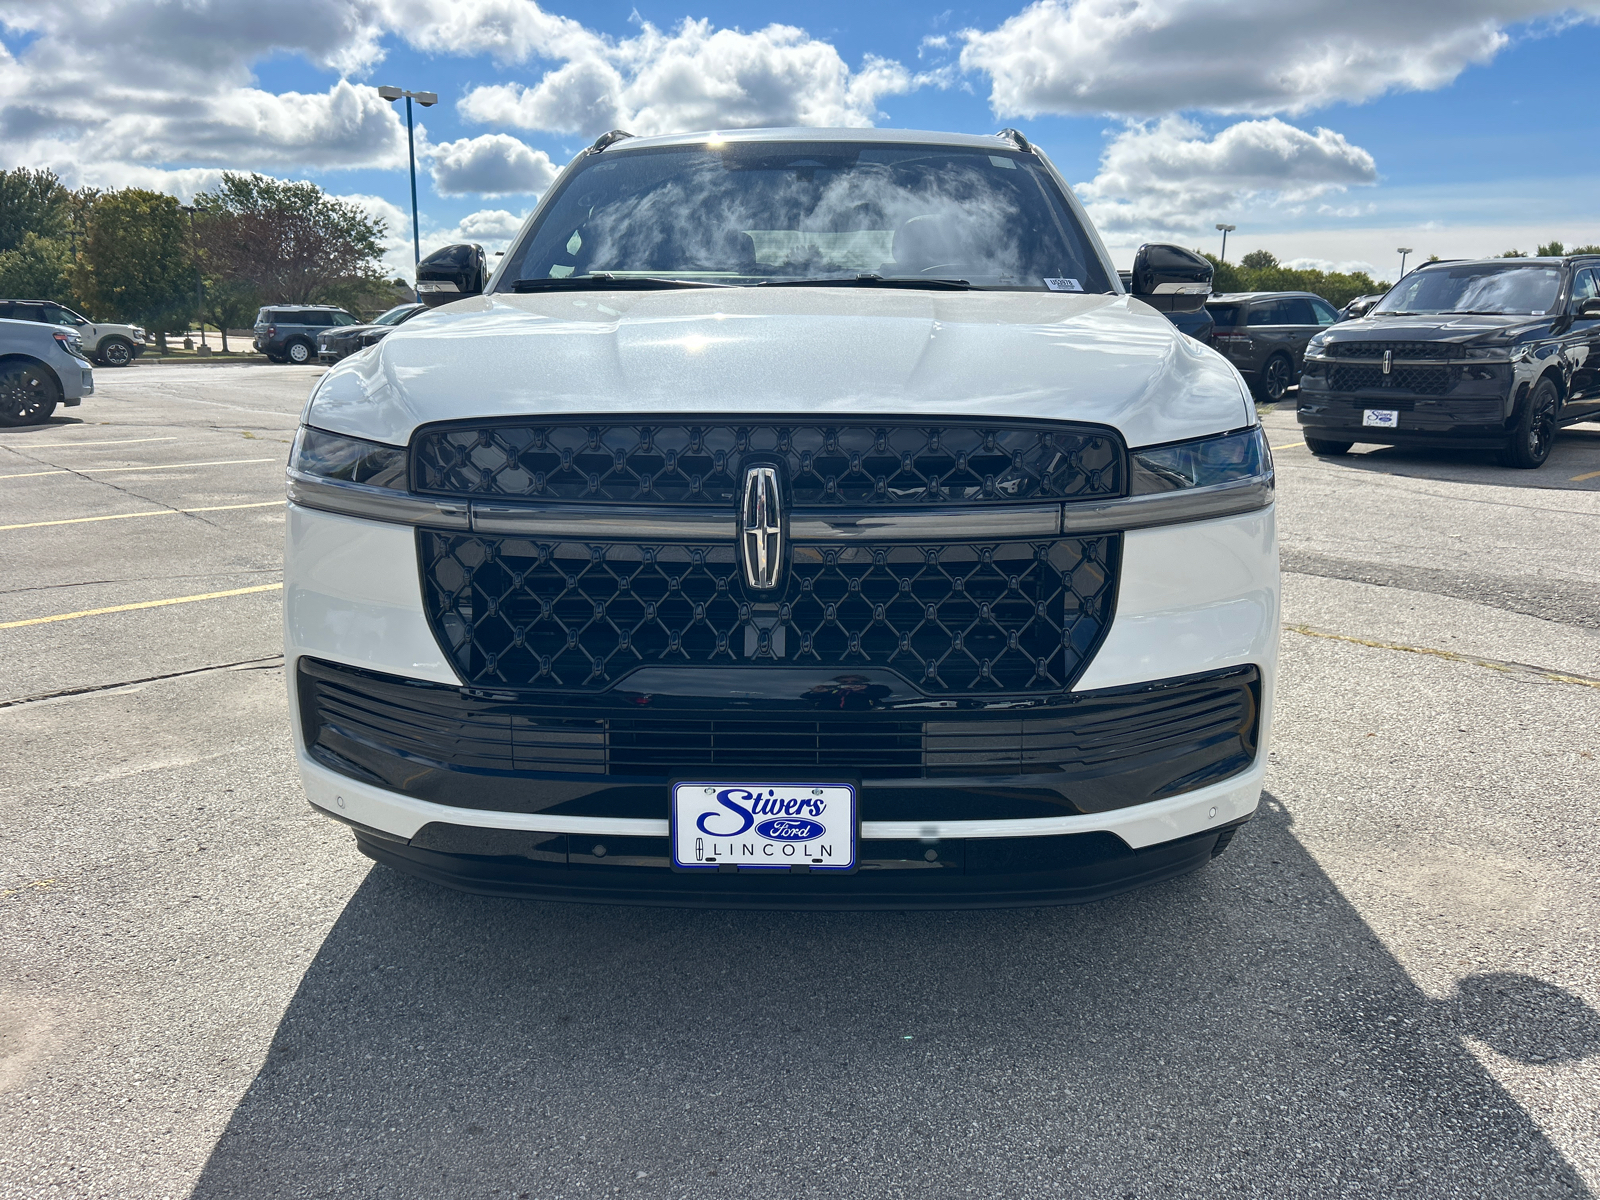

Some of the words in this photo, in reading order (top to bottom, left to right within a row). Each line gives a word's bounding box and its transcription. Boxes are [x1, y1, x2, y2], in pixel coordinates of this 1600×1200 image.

[696, 788, 827, 837] Stivers
[770, 820, 811, 837] Ford
[714, 843, 832, 857] LINCOLN
